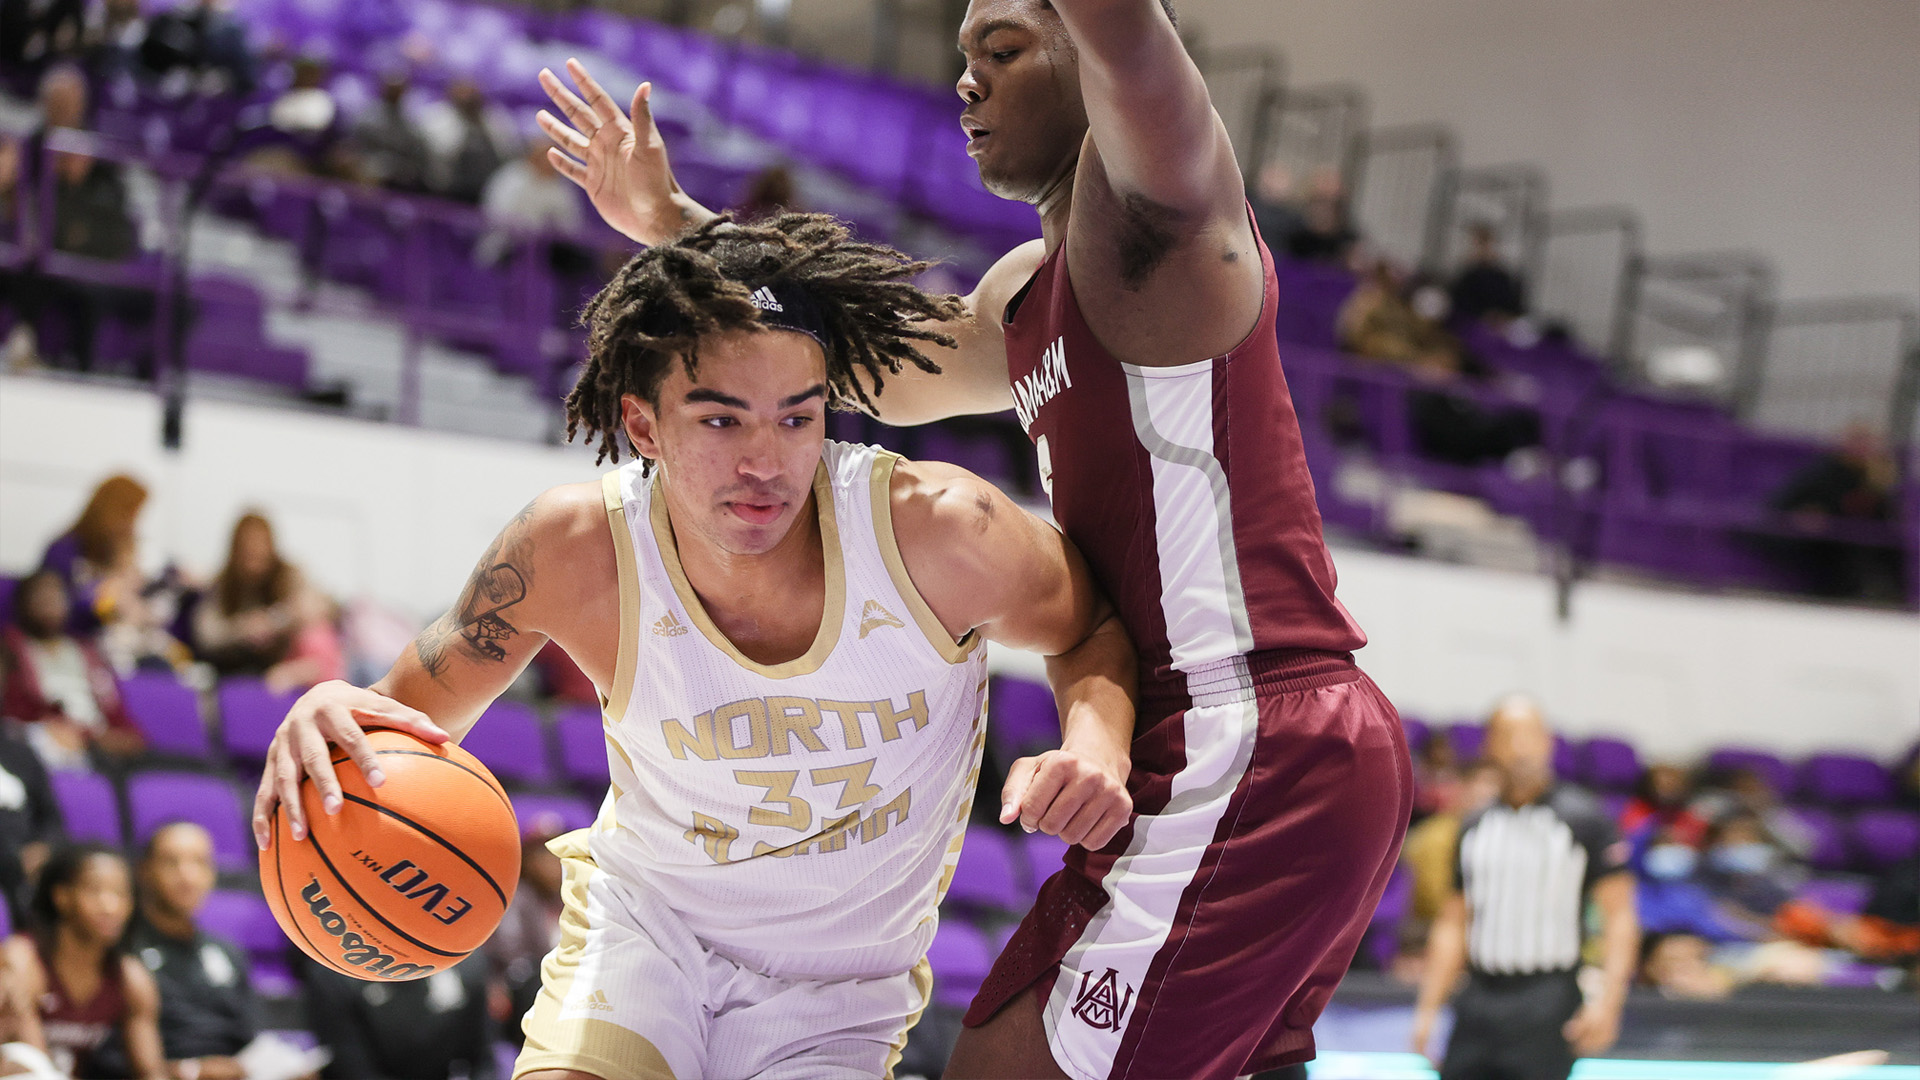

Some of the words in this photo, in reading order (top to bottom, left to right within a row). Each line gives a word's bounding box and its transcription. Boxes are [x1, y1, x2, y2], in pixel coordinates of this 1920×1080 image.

[751, 299, 784, 313] didas
[652, 625, 688, 637] adidas
[661, 688, 930, 762] NORTH
[733, 757, 883, 832] 33
[350, 849, 383, 873] NXT
[301, 876, 436, 980] Wilson
